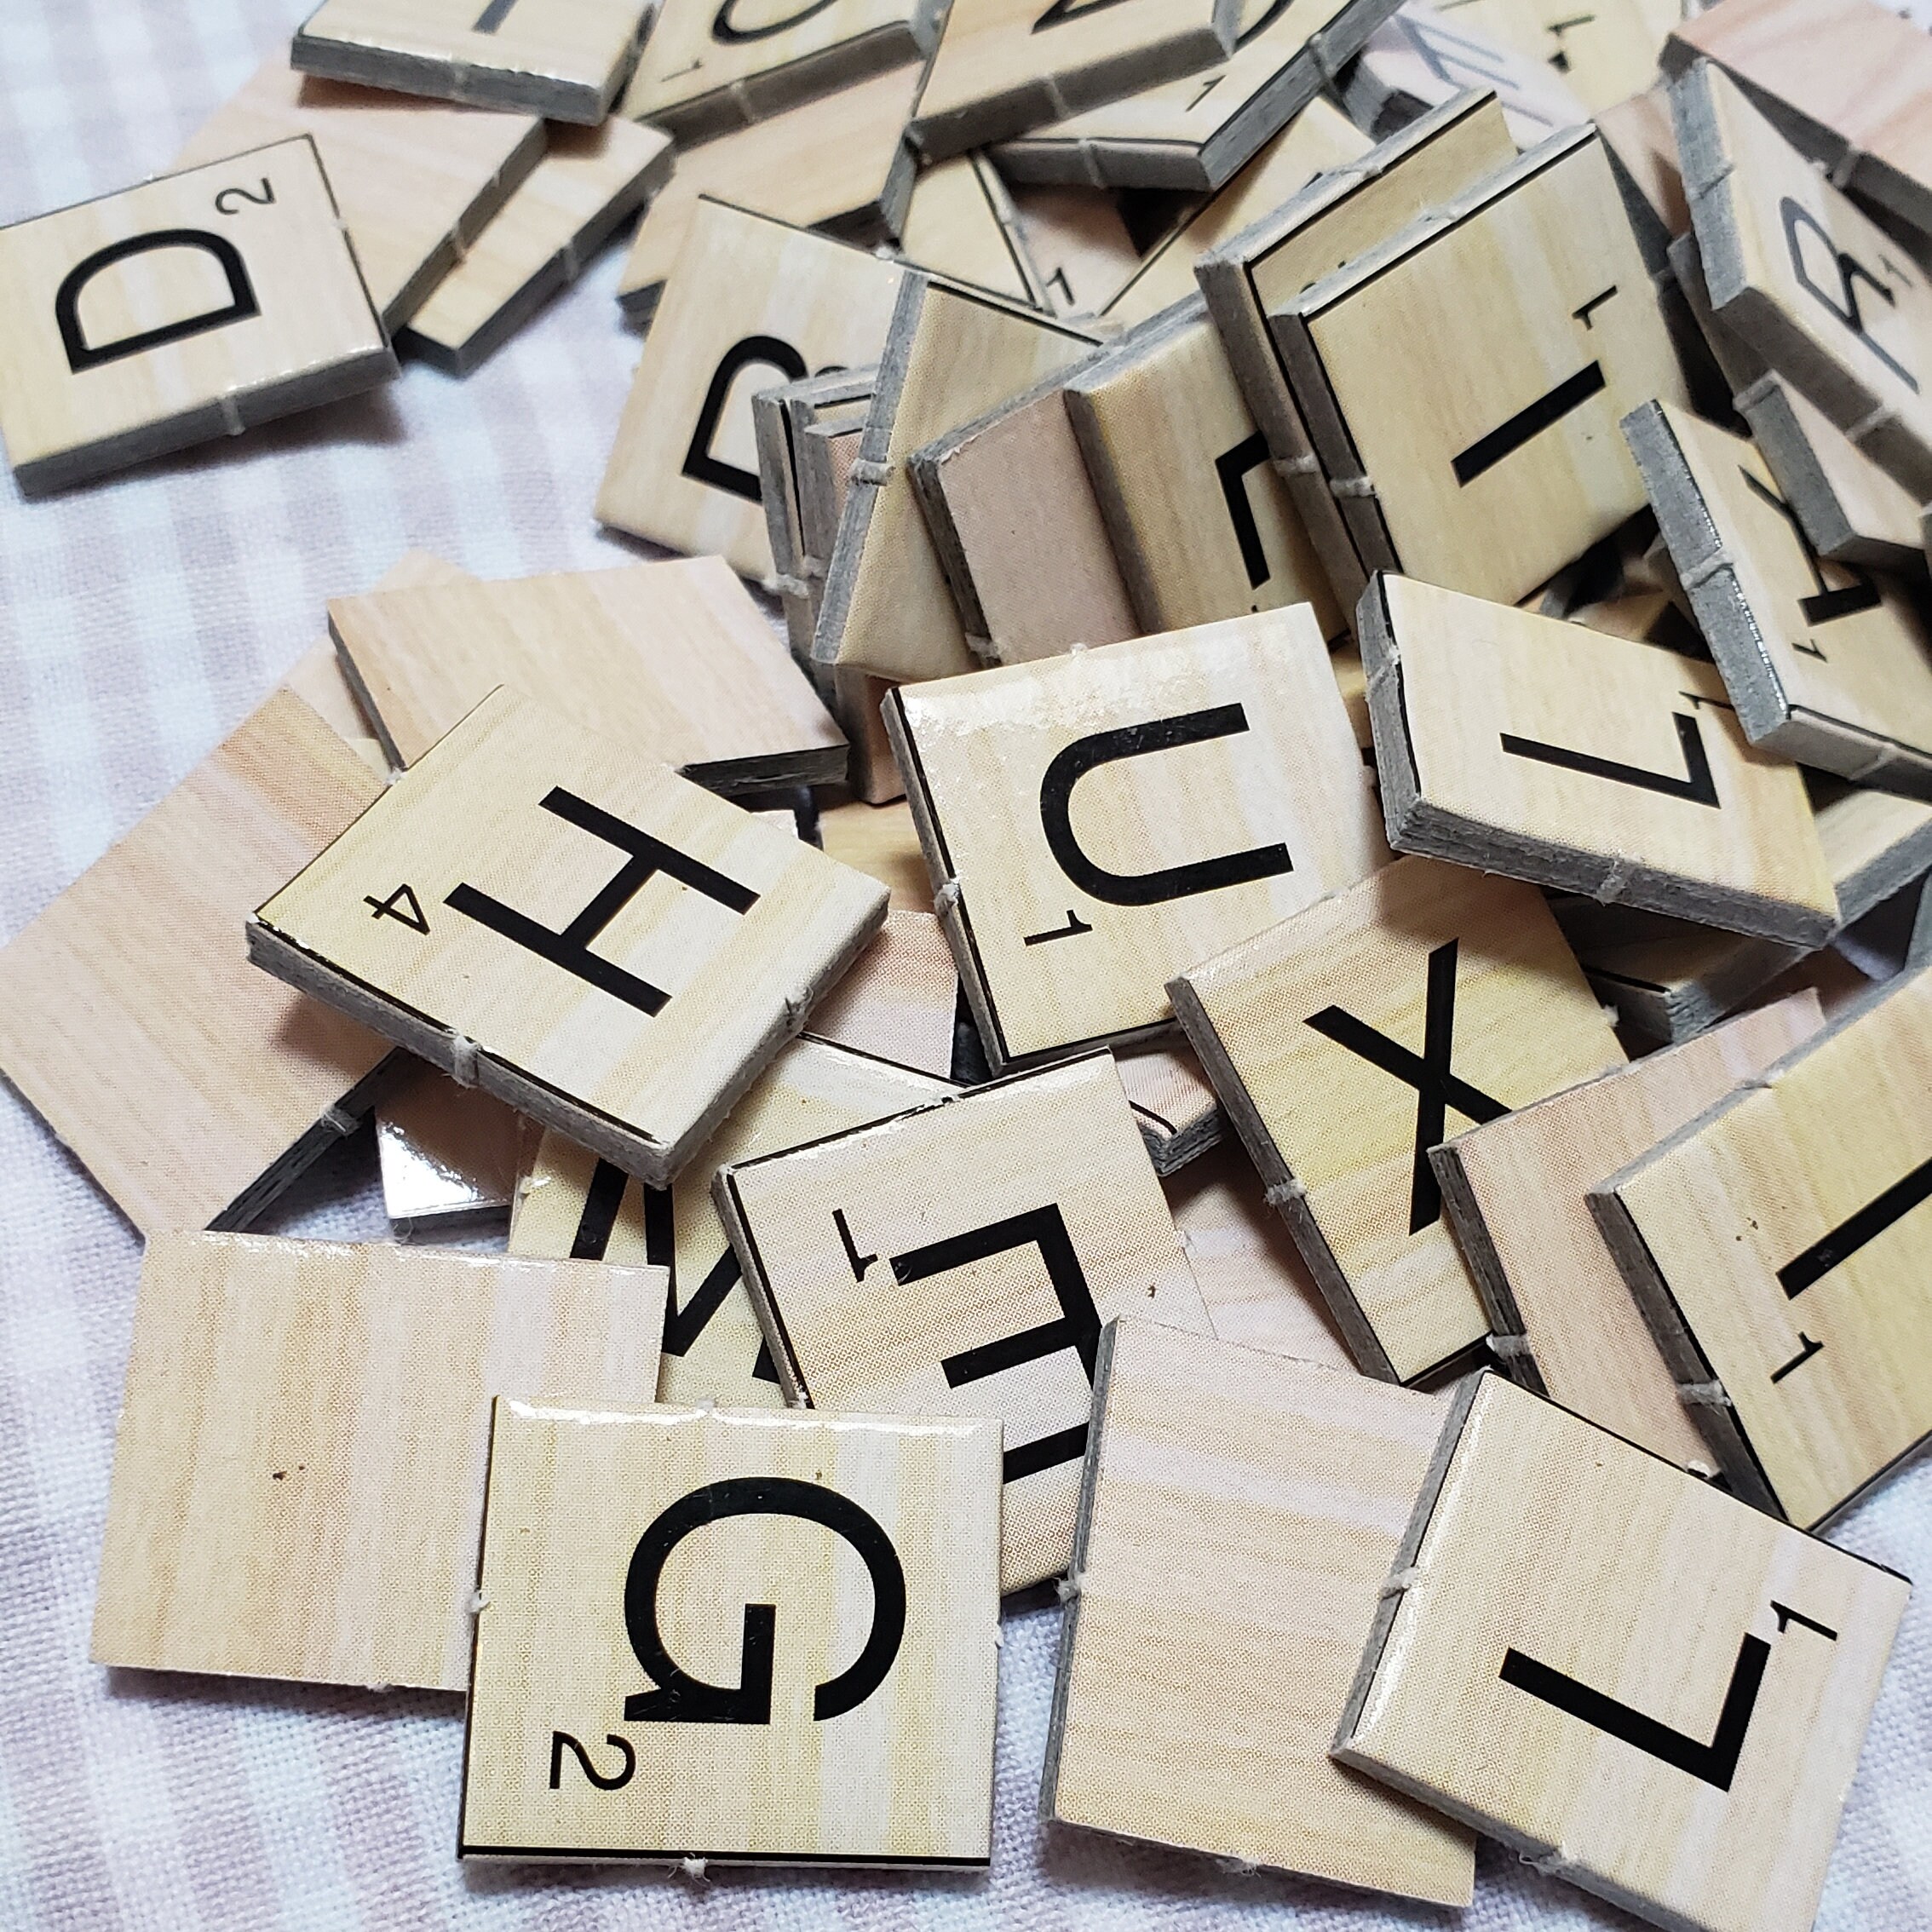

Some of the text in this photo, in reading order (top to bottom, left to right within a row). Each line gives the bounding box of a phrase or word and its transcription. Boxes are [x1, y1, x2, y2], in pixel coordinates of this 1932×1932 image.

[1185, 74, 1228, 112] 1
[55, 177, 276, 375] D 2
[1045, 267, 1076, 306] 1
[1572, 285, 1619, 331] 1
[1780, 196, 1920, 395] R
[1022, 702, 1294, 947] U 1
[1499, 691, 1735, 810] L 1
[362, 785, 762, 1018] H 4
[1302, 937, 1513, 1237] X
[831, 1202, 1103, 1486] E 1
[1769, 1331, 1826, 1385] 1
[548, 1476, 907, 1791] G 2
[1498, 1600, 1838, 1793] L 1
